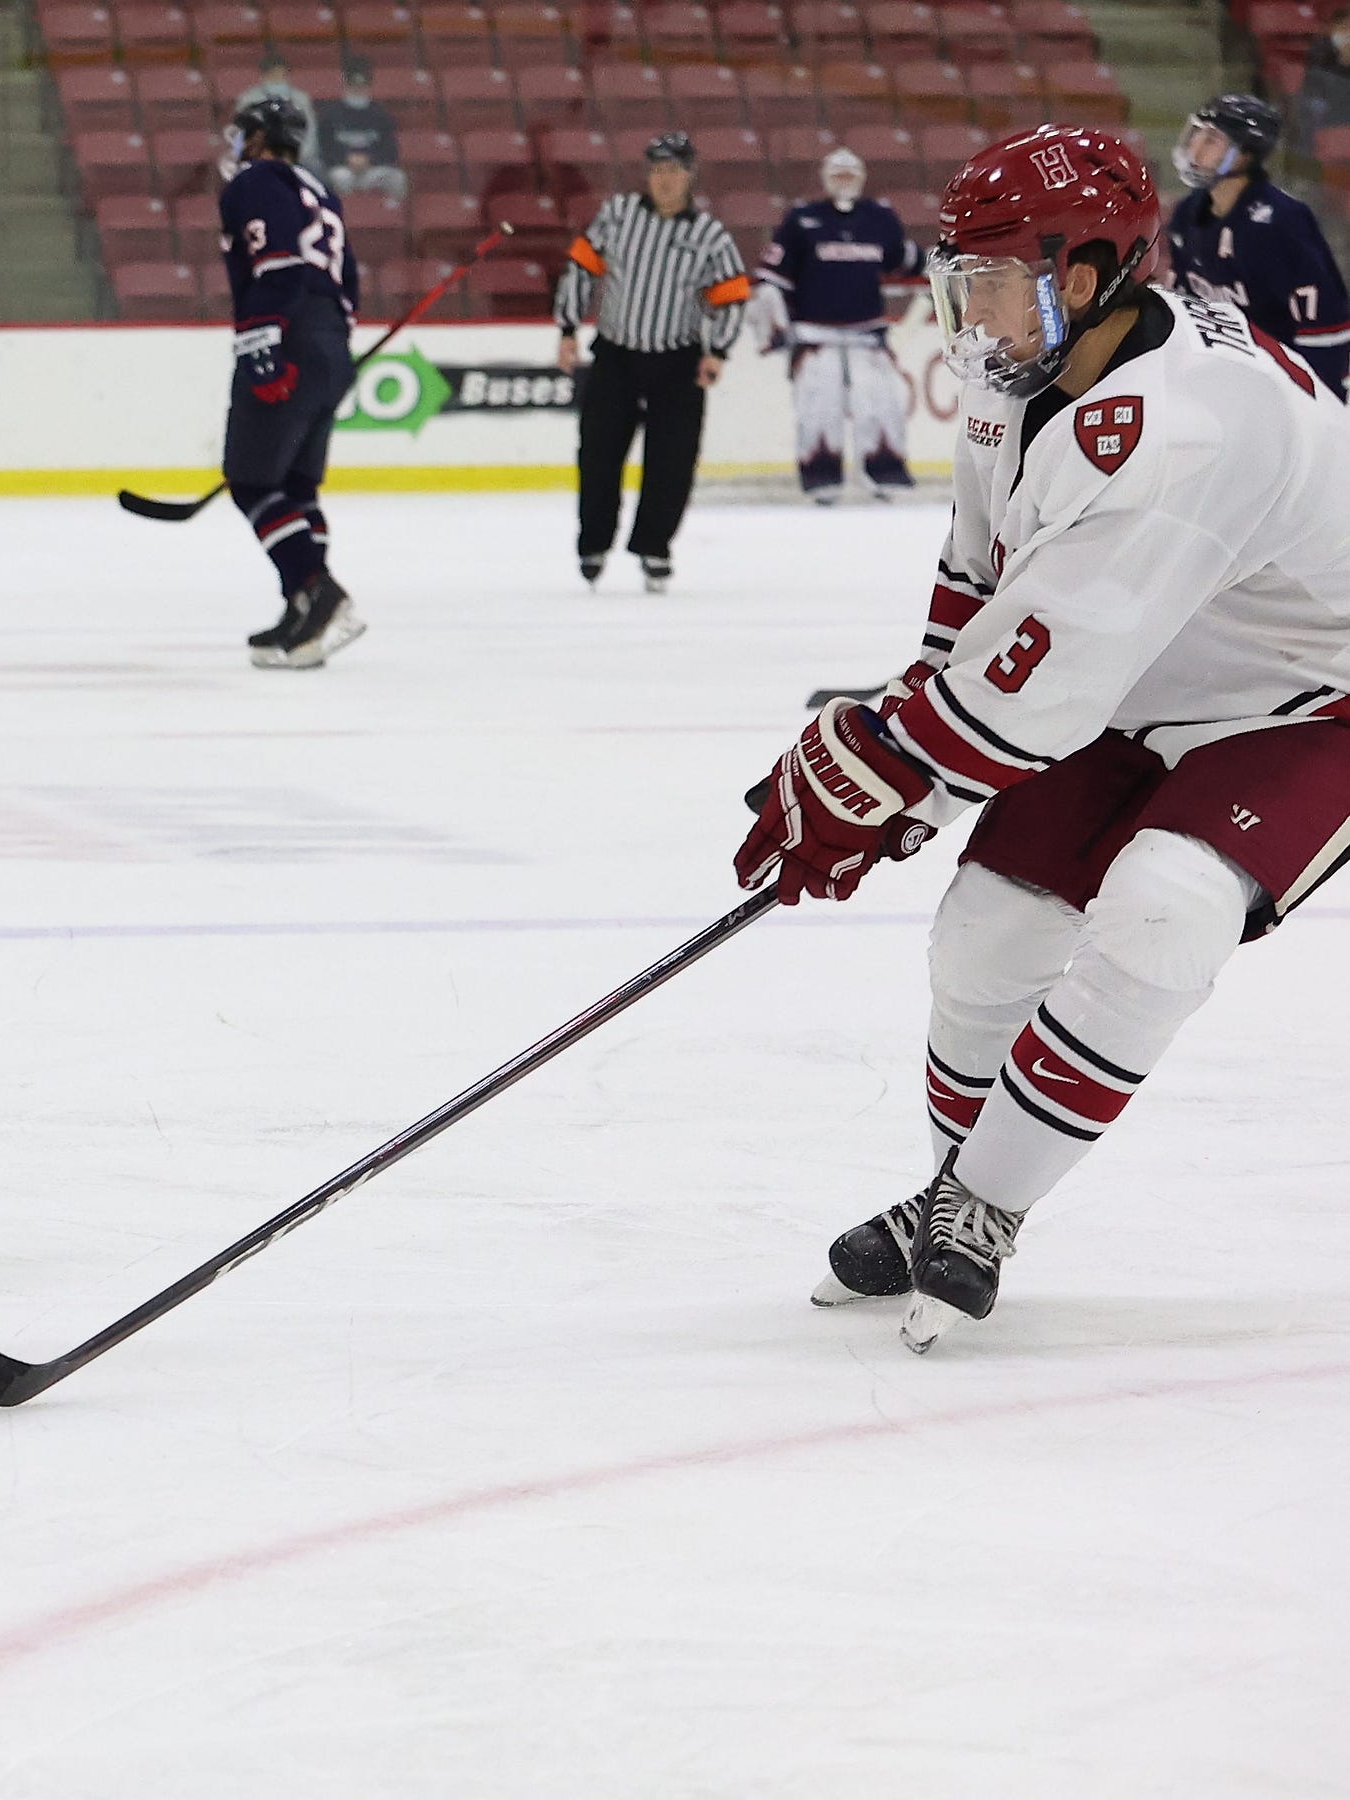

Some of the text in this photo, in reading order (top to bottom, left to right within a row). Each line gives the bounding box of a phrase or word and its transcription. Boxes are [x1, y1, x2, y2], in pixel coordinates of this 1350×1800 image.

[1029, 143, 1079, 190] H
[1288, 284, 1319, 322] 17
[459, 370, 576, 407] Buses
[967, 416, 1006, 437] ECAC
[983, 614, 1052, 694] 3
[800, 718, 882, 819] RRIOR
